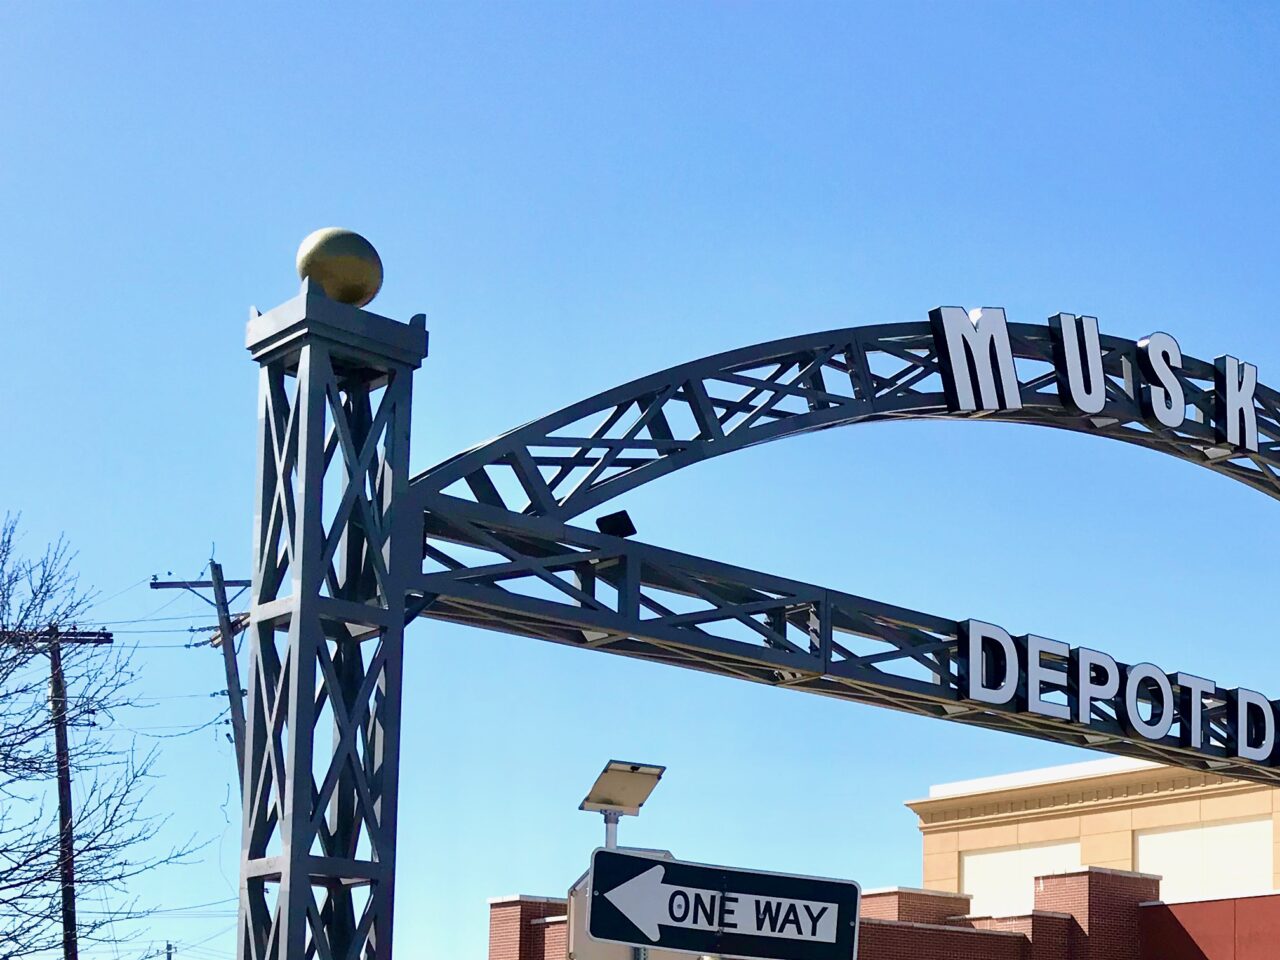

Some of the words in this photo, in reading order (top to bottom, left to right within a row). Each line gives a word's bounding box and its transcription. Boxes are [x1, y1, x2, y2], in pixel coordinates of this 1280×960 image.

[966, 618, 1216, 749] DEPOT
[667, 889, 739, 929] ONE
[754, 899, 829, 937] WAY
